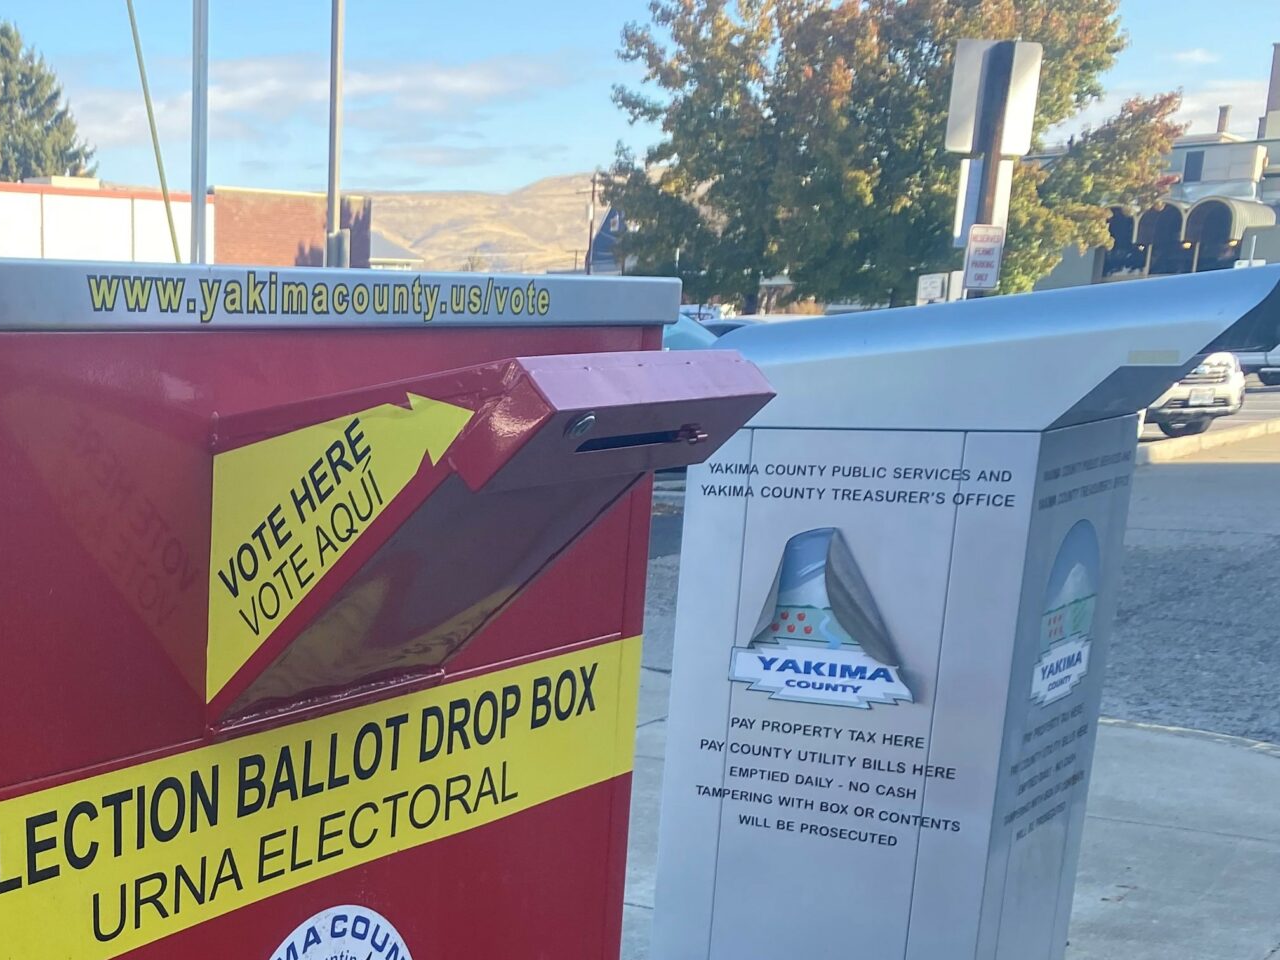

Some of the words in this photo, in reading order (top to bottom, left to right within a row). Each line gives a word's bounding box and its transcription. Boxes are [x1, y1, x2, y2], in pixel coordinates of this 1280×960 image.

[86, 272, 551, 324] www.yakimacounty.us/vote
[708, 462, 760, 476] YAKIMA
[764, 464, 827, 478] COUNTY
[831, 465, 888, 480] PUBLIC
[893, 467, 971, 482] SERVICES
[977, 470, 1013, 483] AND
[217, 503, 293, 598] VOTE
[289, 417, 372, 525] HERE
[701, 484, 755, 498] YAKIMA
[760, 486, 826, 500] COUNTY
[832, 488, 946, 505] TREASURER'S
[952, 492, 1016, 508] OFFICE
[238, 543, 315, 636] VOTE
[315, 455, 384, 567] AQUÍ
[757, 655, 895, 683] YAKIMA
[1040, 650, 1083, 680] YAKIMA
[785, 678, 862, 694] COUNTY
[1047, 673, 1073, 691] COUNTY
[237, 712, 409, 819] BALLOT
[418, 682, 522, 763] DROP
[530, 662, 599, 731] BOX
[730, 717, 756, 729] PAY
[761, 720, 843, 739] PROPERTY
[848, 729, 876, 743] TAX
[882, 733, 925, 749] HERE
[700, 738, 725, 752] PAY
[729, 742, 792, 760] COUNTY
[797, 750, 857, 768] UTILITY
[862, 758, 907, 774] BILLS
[912, 764, 957, 780] HERE
[729, 766, 790, 783] EMPTIED
[795, 774, 834, 789] DAILY
[848, 780, 870, 794] NO
[875, 784, 917, 800] CASH
[696, 785, 773, 805] TAMPERING
[778, 795, 815, 810] WITH
[819, 801, 849, 815] BOX
[854, 805, 875, 819] OR
[878, 810, 961, 832] CONTENTS
[738, 814, 771, 829] WILL
[776, 819, 795, 832] BE
[800, 822, 898, 847] PROSECUTED
[91, 847, 243, 944] URNA
[256, 759, 520, 880] ELECTORAL
